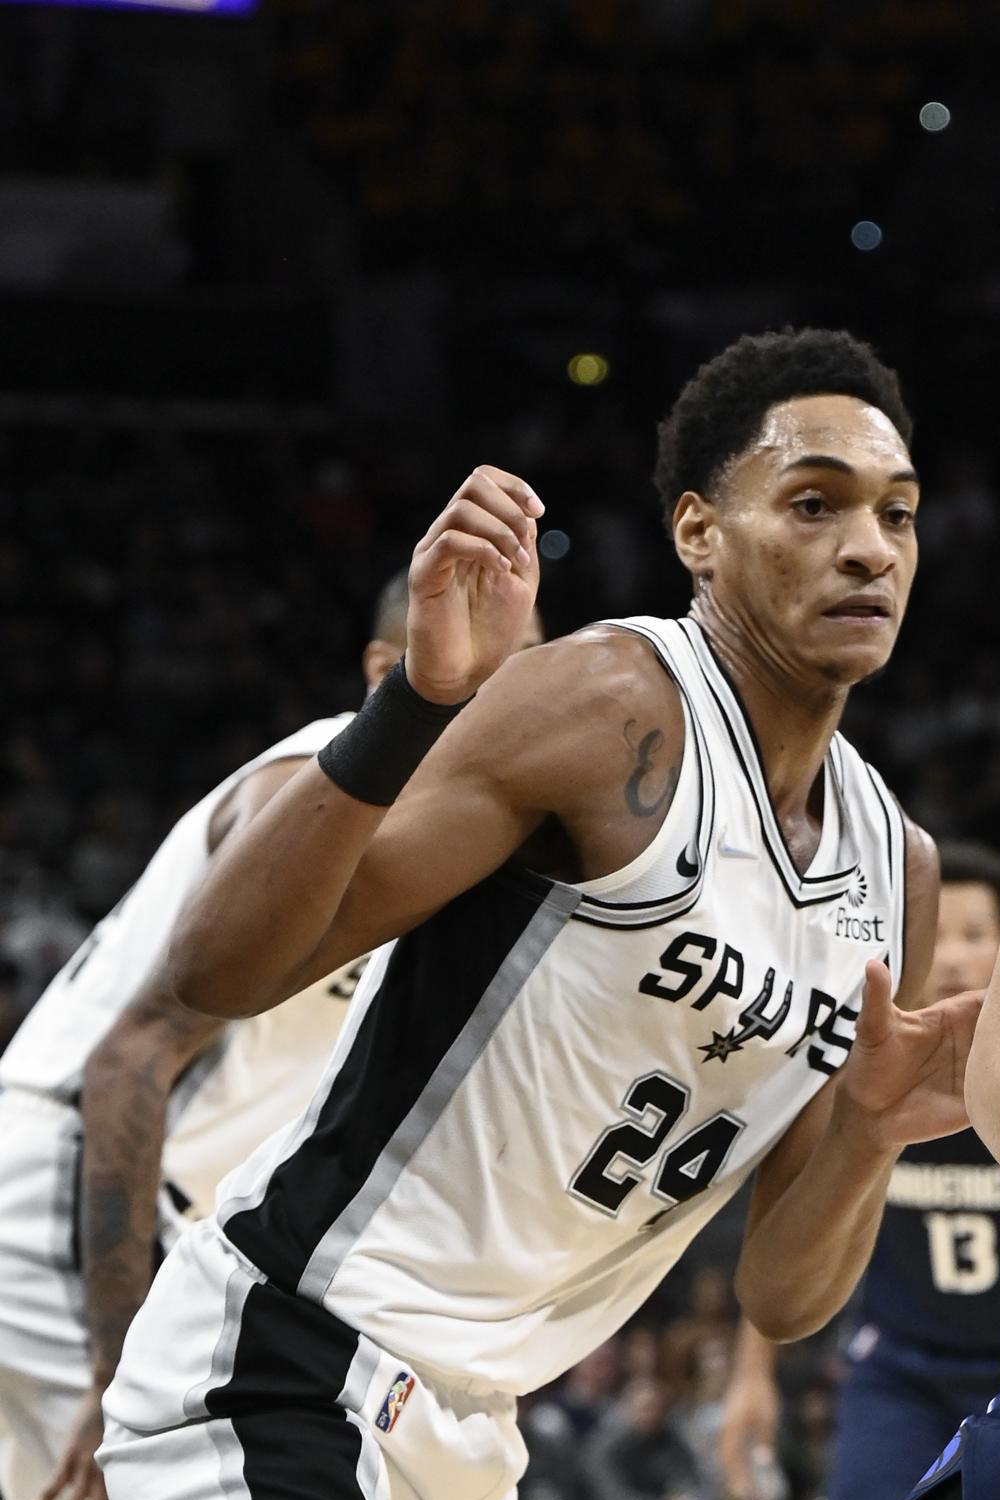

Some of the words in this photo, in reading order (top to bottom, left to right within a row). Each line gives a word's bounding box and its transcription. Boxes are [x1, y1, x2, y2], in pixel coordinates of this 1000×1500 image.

[835, 907, 886, 942] Frost
[567, 1070, 747, 1219] 24
[923, 1210, 999, 1295] 13
